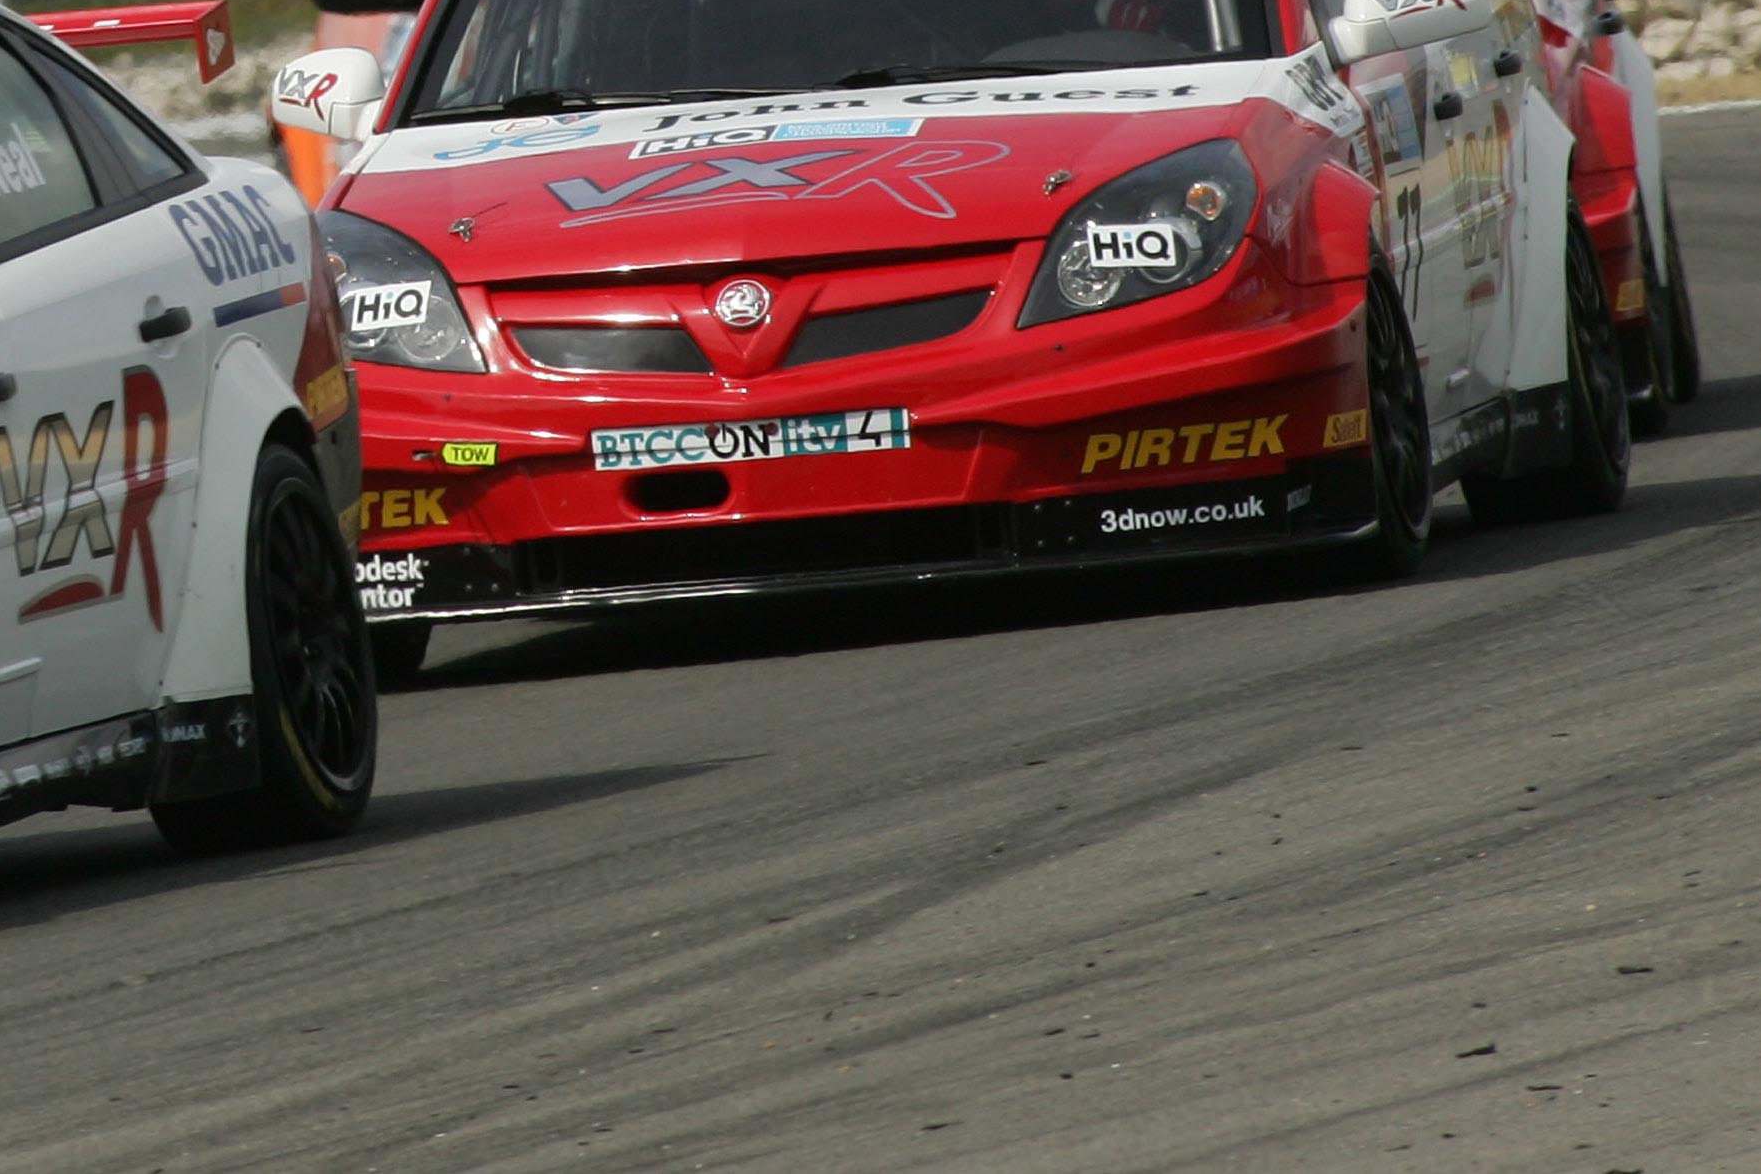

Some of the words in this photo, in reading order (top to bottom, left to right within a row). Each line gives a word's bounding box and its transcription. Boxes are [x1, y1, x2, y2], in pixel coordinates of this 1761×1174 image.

[278, 67, 338, 121] VXR
[642, 100, 872, 132] John
[903, 83, 1201, 106] Guest
[645, 130, 767, 154] HiQ
[545, 140, 1011, 218] VXR
[168, 184, 296, 286] GMAC
[1092, 229, 1172, 262] HiQ
[356, 287, 423, 324] HiQ
[453, 447, 490, 462] TOW
[596, 427, 705, 467] BTCC
[709, 423, 771, 459] ON
[1081, 414, 1289, 473] PIRTEK
[1100, 494, 1265, 532] 3dnow.co.uk
